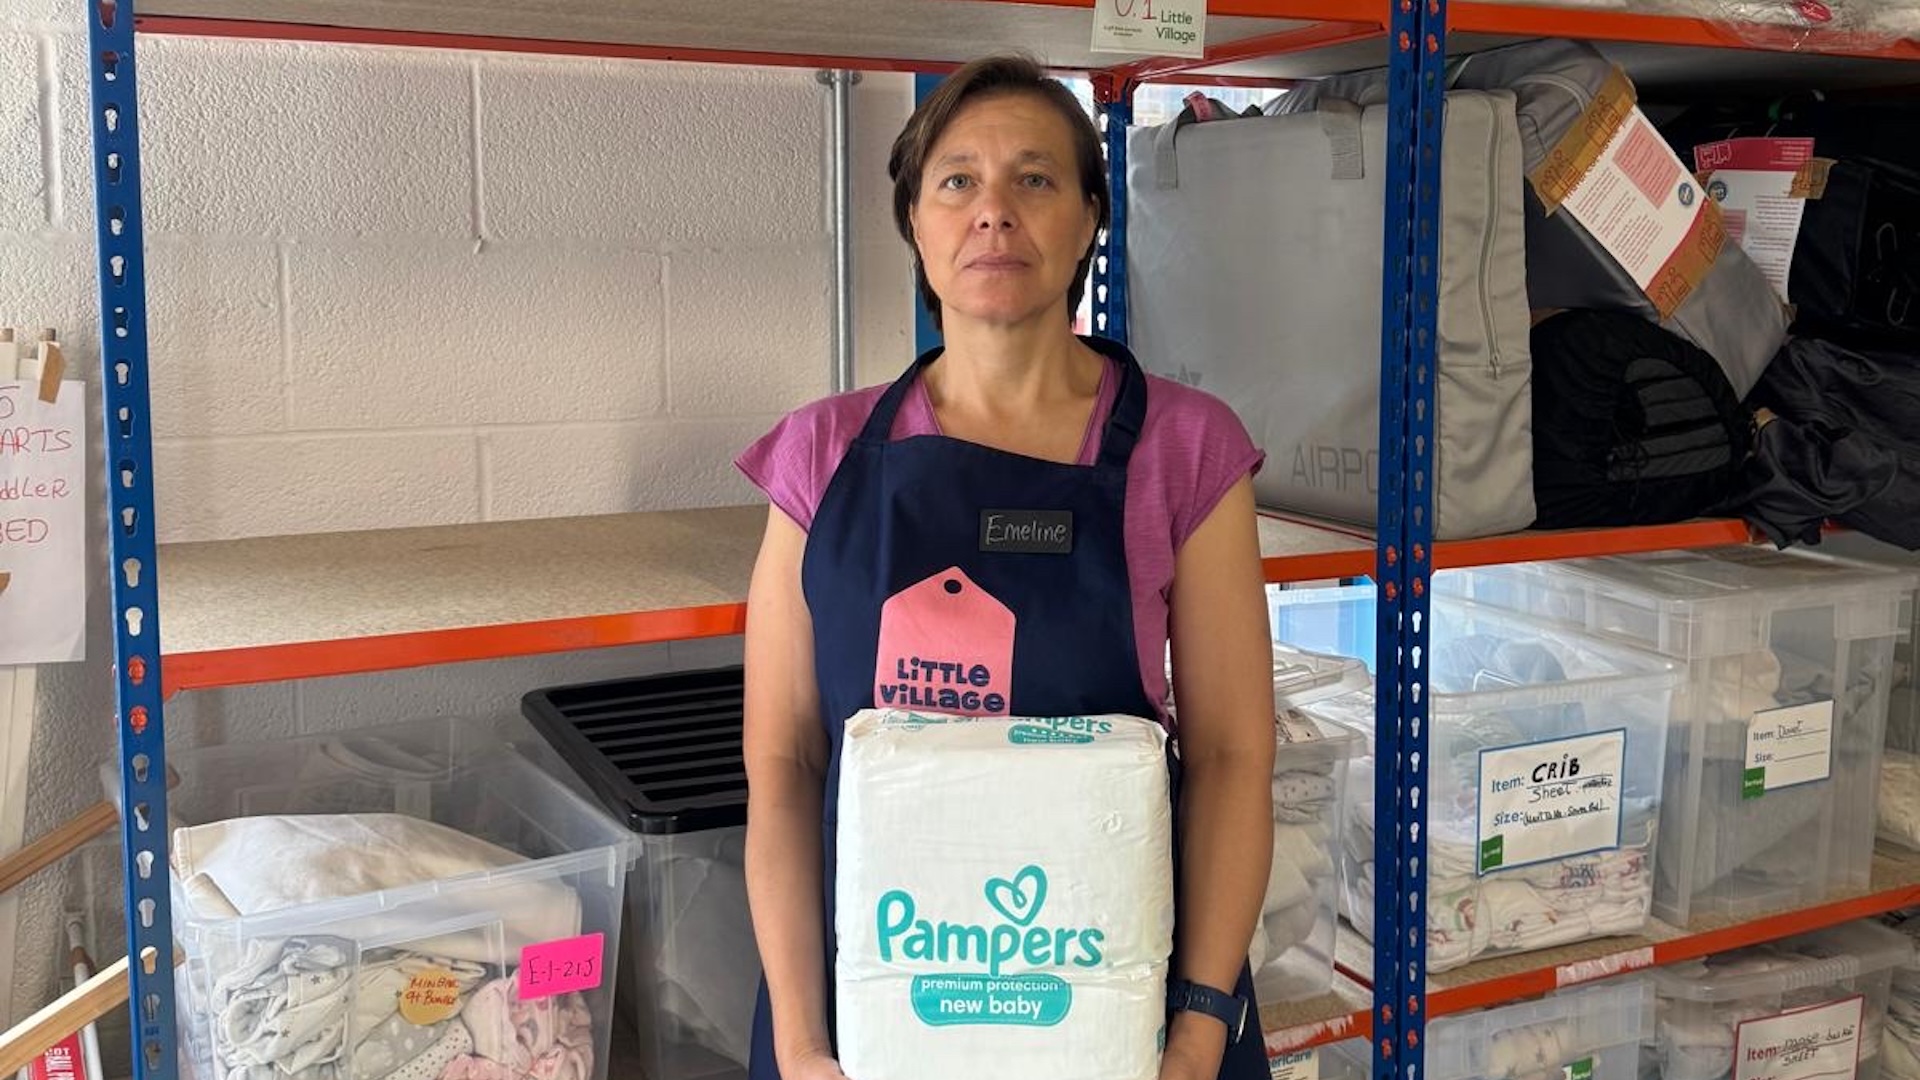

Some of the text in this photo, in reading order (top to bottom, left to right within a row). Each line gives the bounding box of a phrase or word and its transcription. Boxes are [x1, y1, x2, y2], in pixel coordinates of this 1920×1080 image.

[1160, 9, 1193, 25] Little
[1155, 26, 1197, 44] Village
[986, 514, 1067, 545] Emeline
[1491, 776, 1525, 793] Item:
[876, 889, 1105, 977] Pampers
[920, 977, 1060, 993] premium protection
[940, 994, 1042, 1019] new baby
